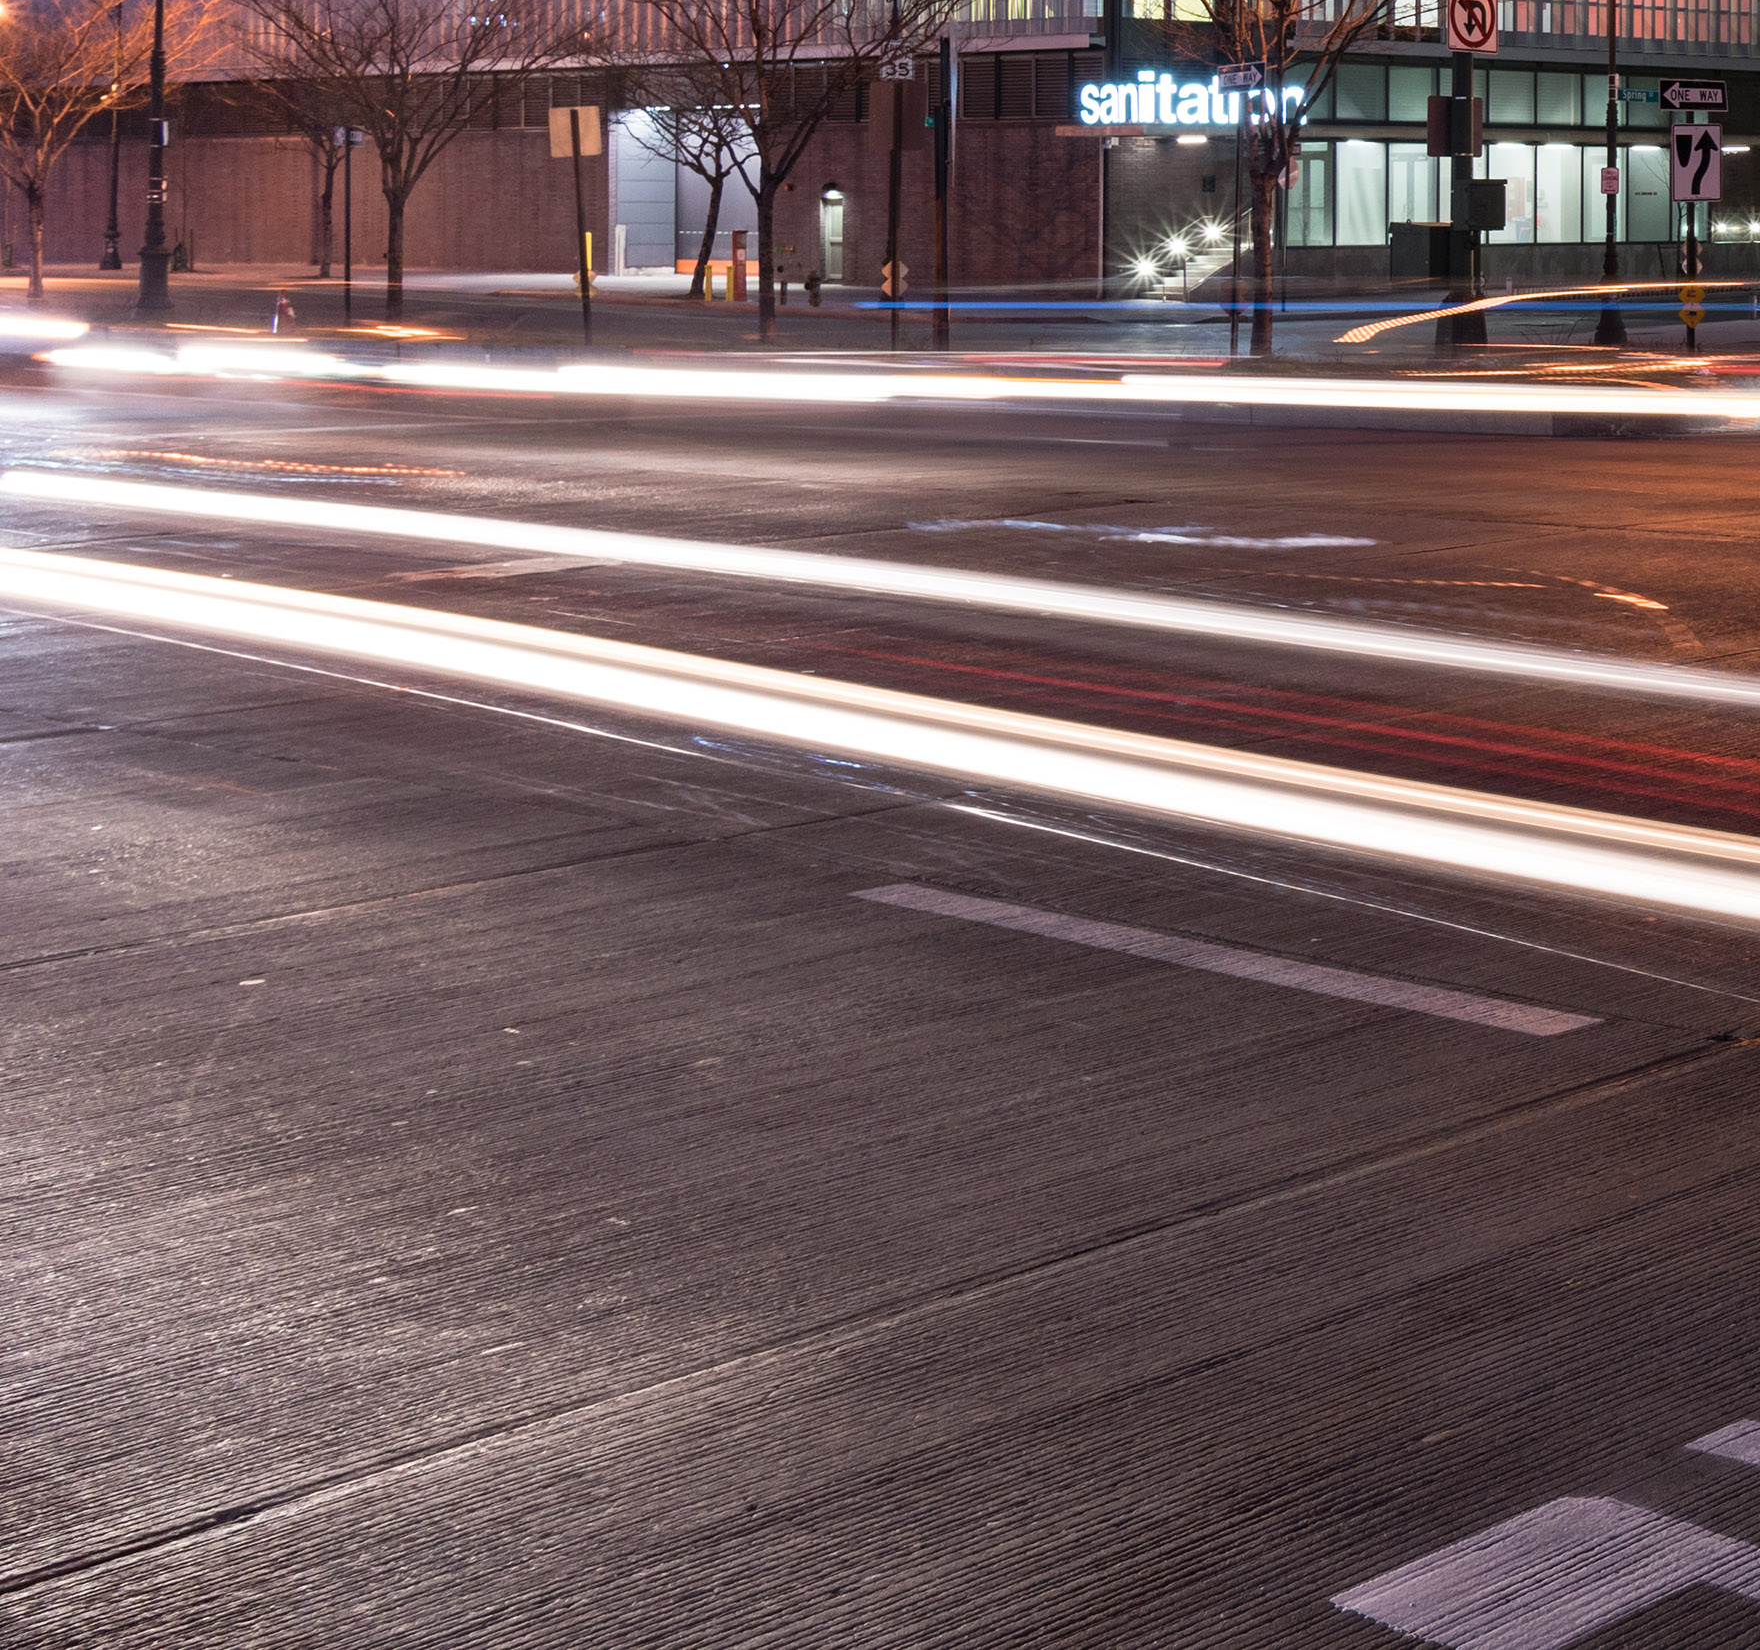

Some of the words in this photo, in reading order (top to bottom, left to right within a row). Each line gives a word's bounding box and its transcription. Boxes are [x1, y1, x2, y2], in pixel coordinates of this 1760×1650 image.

[885, 62, 910, 77] 35
[1223, 73, 1238, 85] ONE
[1242, 71, 1258, 84] WAY
[1622, 90, 1647, 102] Spring
[1670, 89, 1691, 101] ONE
[1700, 90, 1719, 101] WAY
